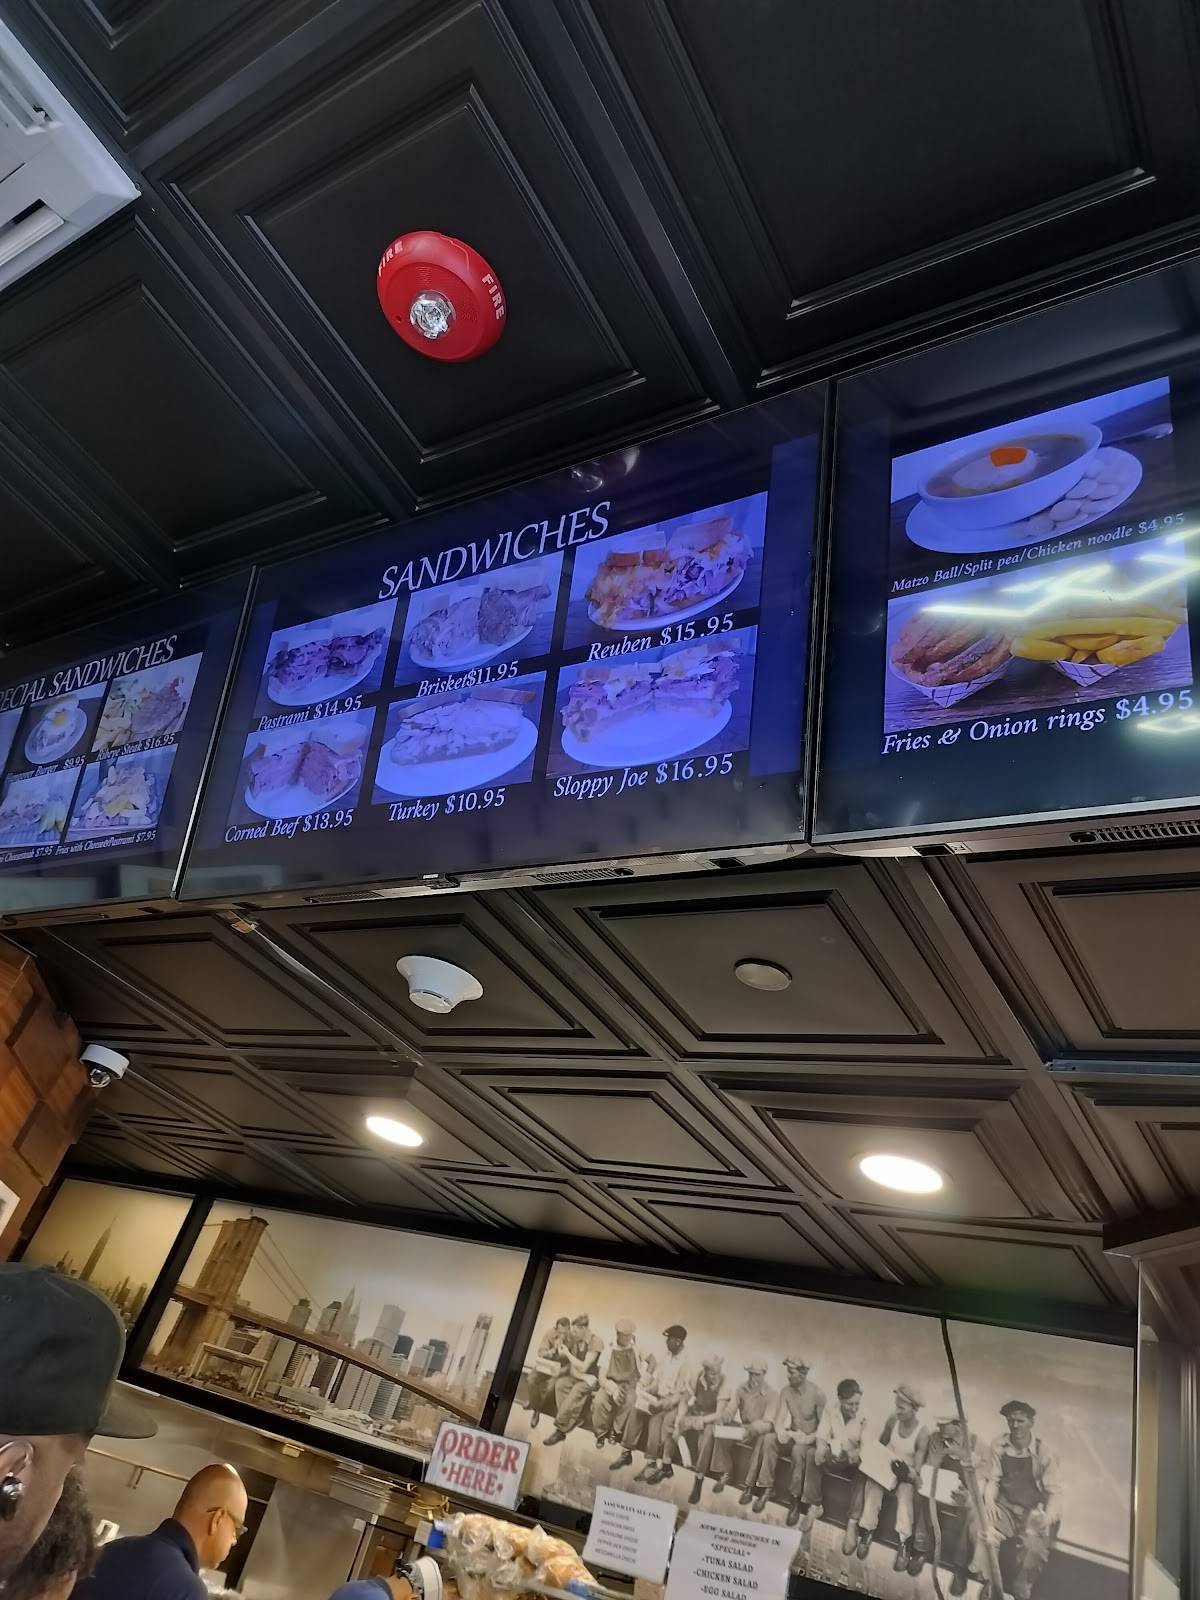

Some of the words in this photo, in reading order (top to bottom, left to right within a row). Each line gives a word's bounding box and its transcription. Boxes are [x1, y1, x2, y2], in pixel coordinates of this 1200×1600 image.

[378, 240, 403, 277] FIRE
[481, 273, 505, 320] FIRE
[378, 501, 611, 599] SANDWICHES
[891, 576, 930, 593] Matzo
[933, 559, 993, 584] Ball/Split
[996, 538, 1083, 570] pea/Chicken
[1087, 525, 1134, 547] noodle
[1137, 512, 1186, 535] $4.95
[588, 636, 652, 661] Reuben
[659, 612, 735, 646] $15.95
[0, 677, 46, 709] ECIAL
[49, 635, 178, 697] SANDWICHES
[257, 706, 311, 731] Pastrami
[313, 694, 363, 720] $14.95
[880, 733, 931, 755] Fries
[937, 728, 963, 746] &
[969, 716, 1039, 743] Onion
[1046, 705, 1107, 731] rings
[1115, 689, 1195, 722] $4.95
[143, 732, 176, 751] $16.95
[553, 776, 613, 800] Sloppy
[616, 767, 649, 795] Joe
[655, 752, 733, 785] $16.95
[224, 820, 270, 844] Corned
[270, 815, 300, 839] Beef
[302, 808, 354, 833] $13.95
[388, 799, 440, 822] Turkey
[444, 787, 506, 815] $10.95
[438, 1428, 521, 1475] ORDER
[727, 1560, 754, 1574] SALAD
[732, 1577, 759, 1591] SALAD
